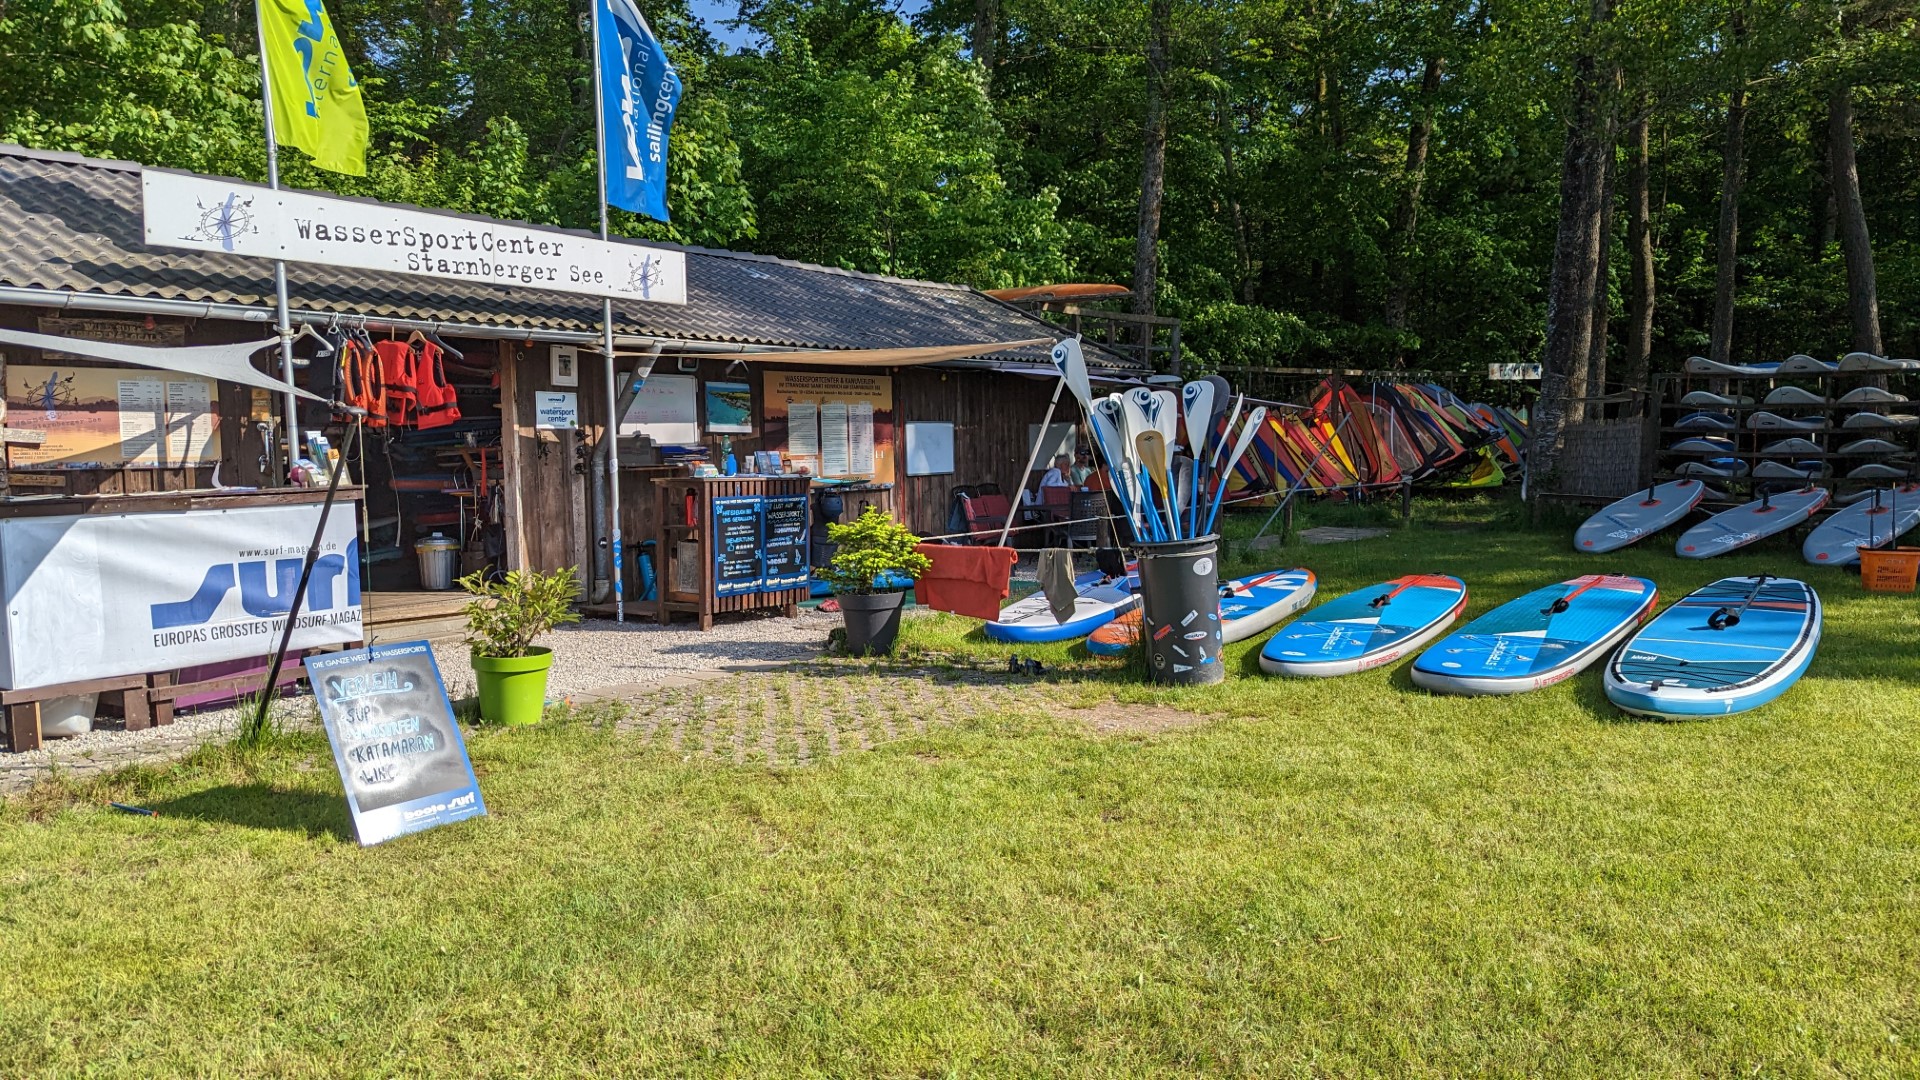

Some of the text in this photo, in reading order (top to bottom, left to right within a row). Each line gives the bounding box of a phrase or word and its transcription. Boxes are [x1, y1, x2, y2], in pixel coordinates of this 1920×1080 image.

[294, 218, 564, 257] WasserSportCenter
[407, 252, 604, 284] Starnberger See
[540, 408, 575, 417] watersport
[153, 628, 208, 648] EUROPAS
[312, 661, 325, 669] DIE
[325, 656, 351, 667] GANZE
[350, 653, 367, 663] WELT
[331, 671, 399, 697] VERLEIH
[346, 705, 371, 724] SUP
[355, 732, 435, 764] KATAMARAN
